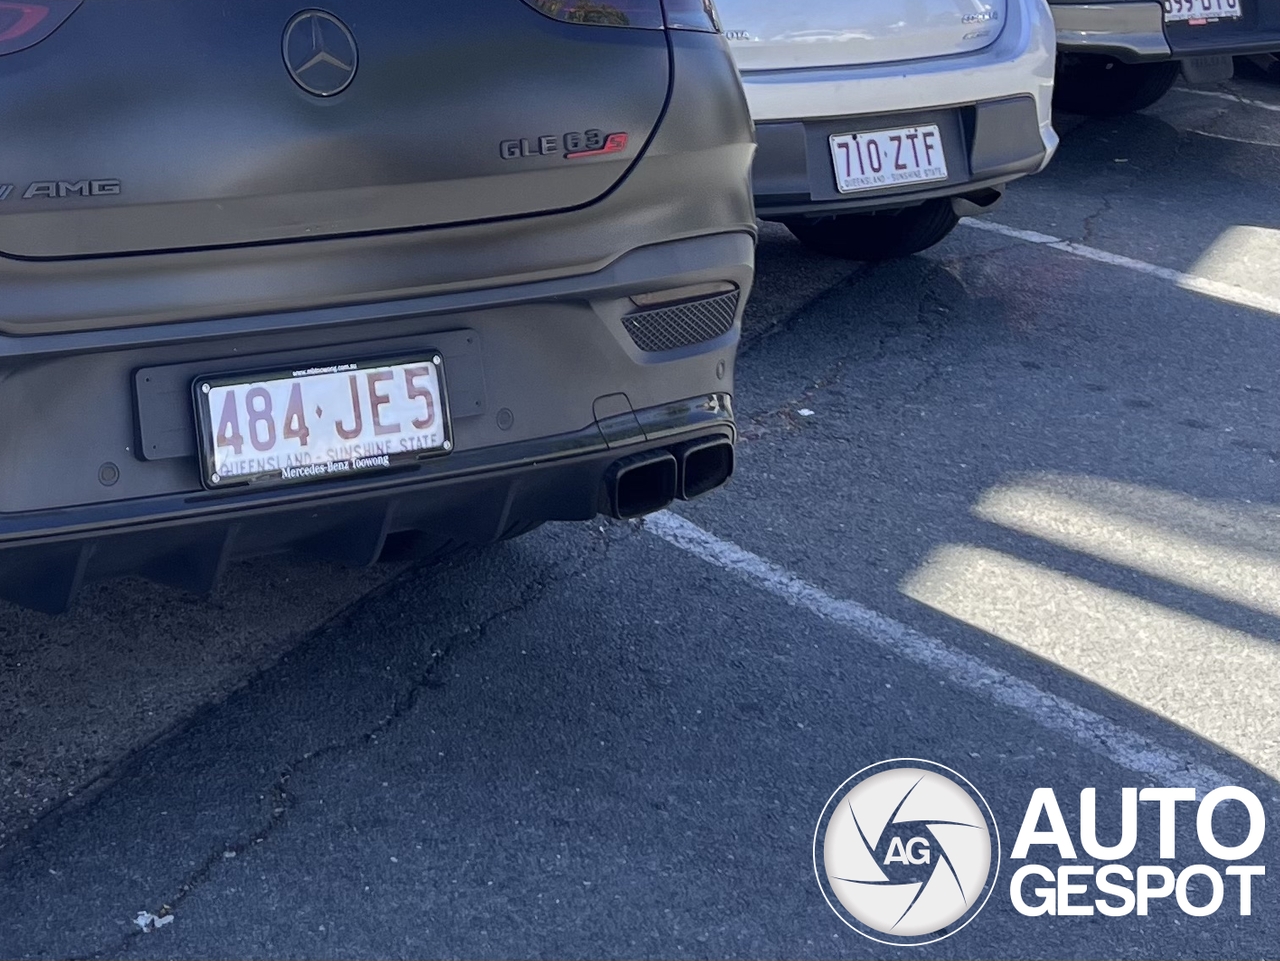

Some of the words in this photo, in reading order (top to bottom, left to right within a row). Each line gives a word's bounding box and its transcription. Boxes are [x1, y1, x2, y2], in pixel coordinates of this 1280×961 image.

[500, 134, 558, 160] GLE
[837, 138, 883, 178] 710
[889, 131, 935, 171] ZTF
[22, 178, 120, 200] AMG
[843, 174, 886, 188] QUEENSLAND
[891, 169, 922, 182] SUNSHINE
[923, 166, 942, 178] STATE
[216, 381, 310, 456] 484
[334, 366, 436, 441] JE5
[221, 451, 312, 477] QUEENSLAND
[326, 439, 392, 461] SUNSHINE
[400, 433, 438, 451] STATE
[281, 460, 349, 480] Mercedes-Benz
[351, 453, 389, 470] Toowong
